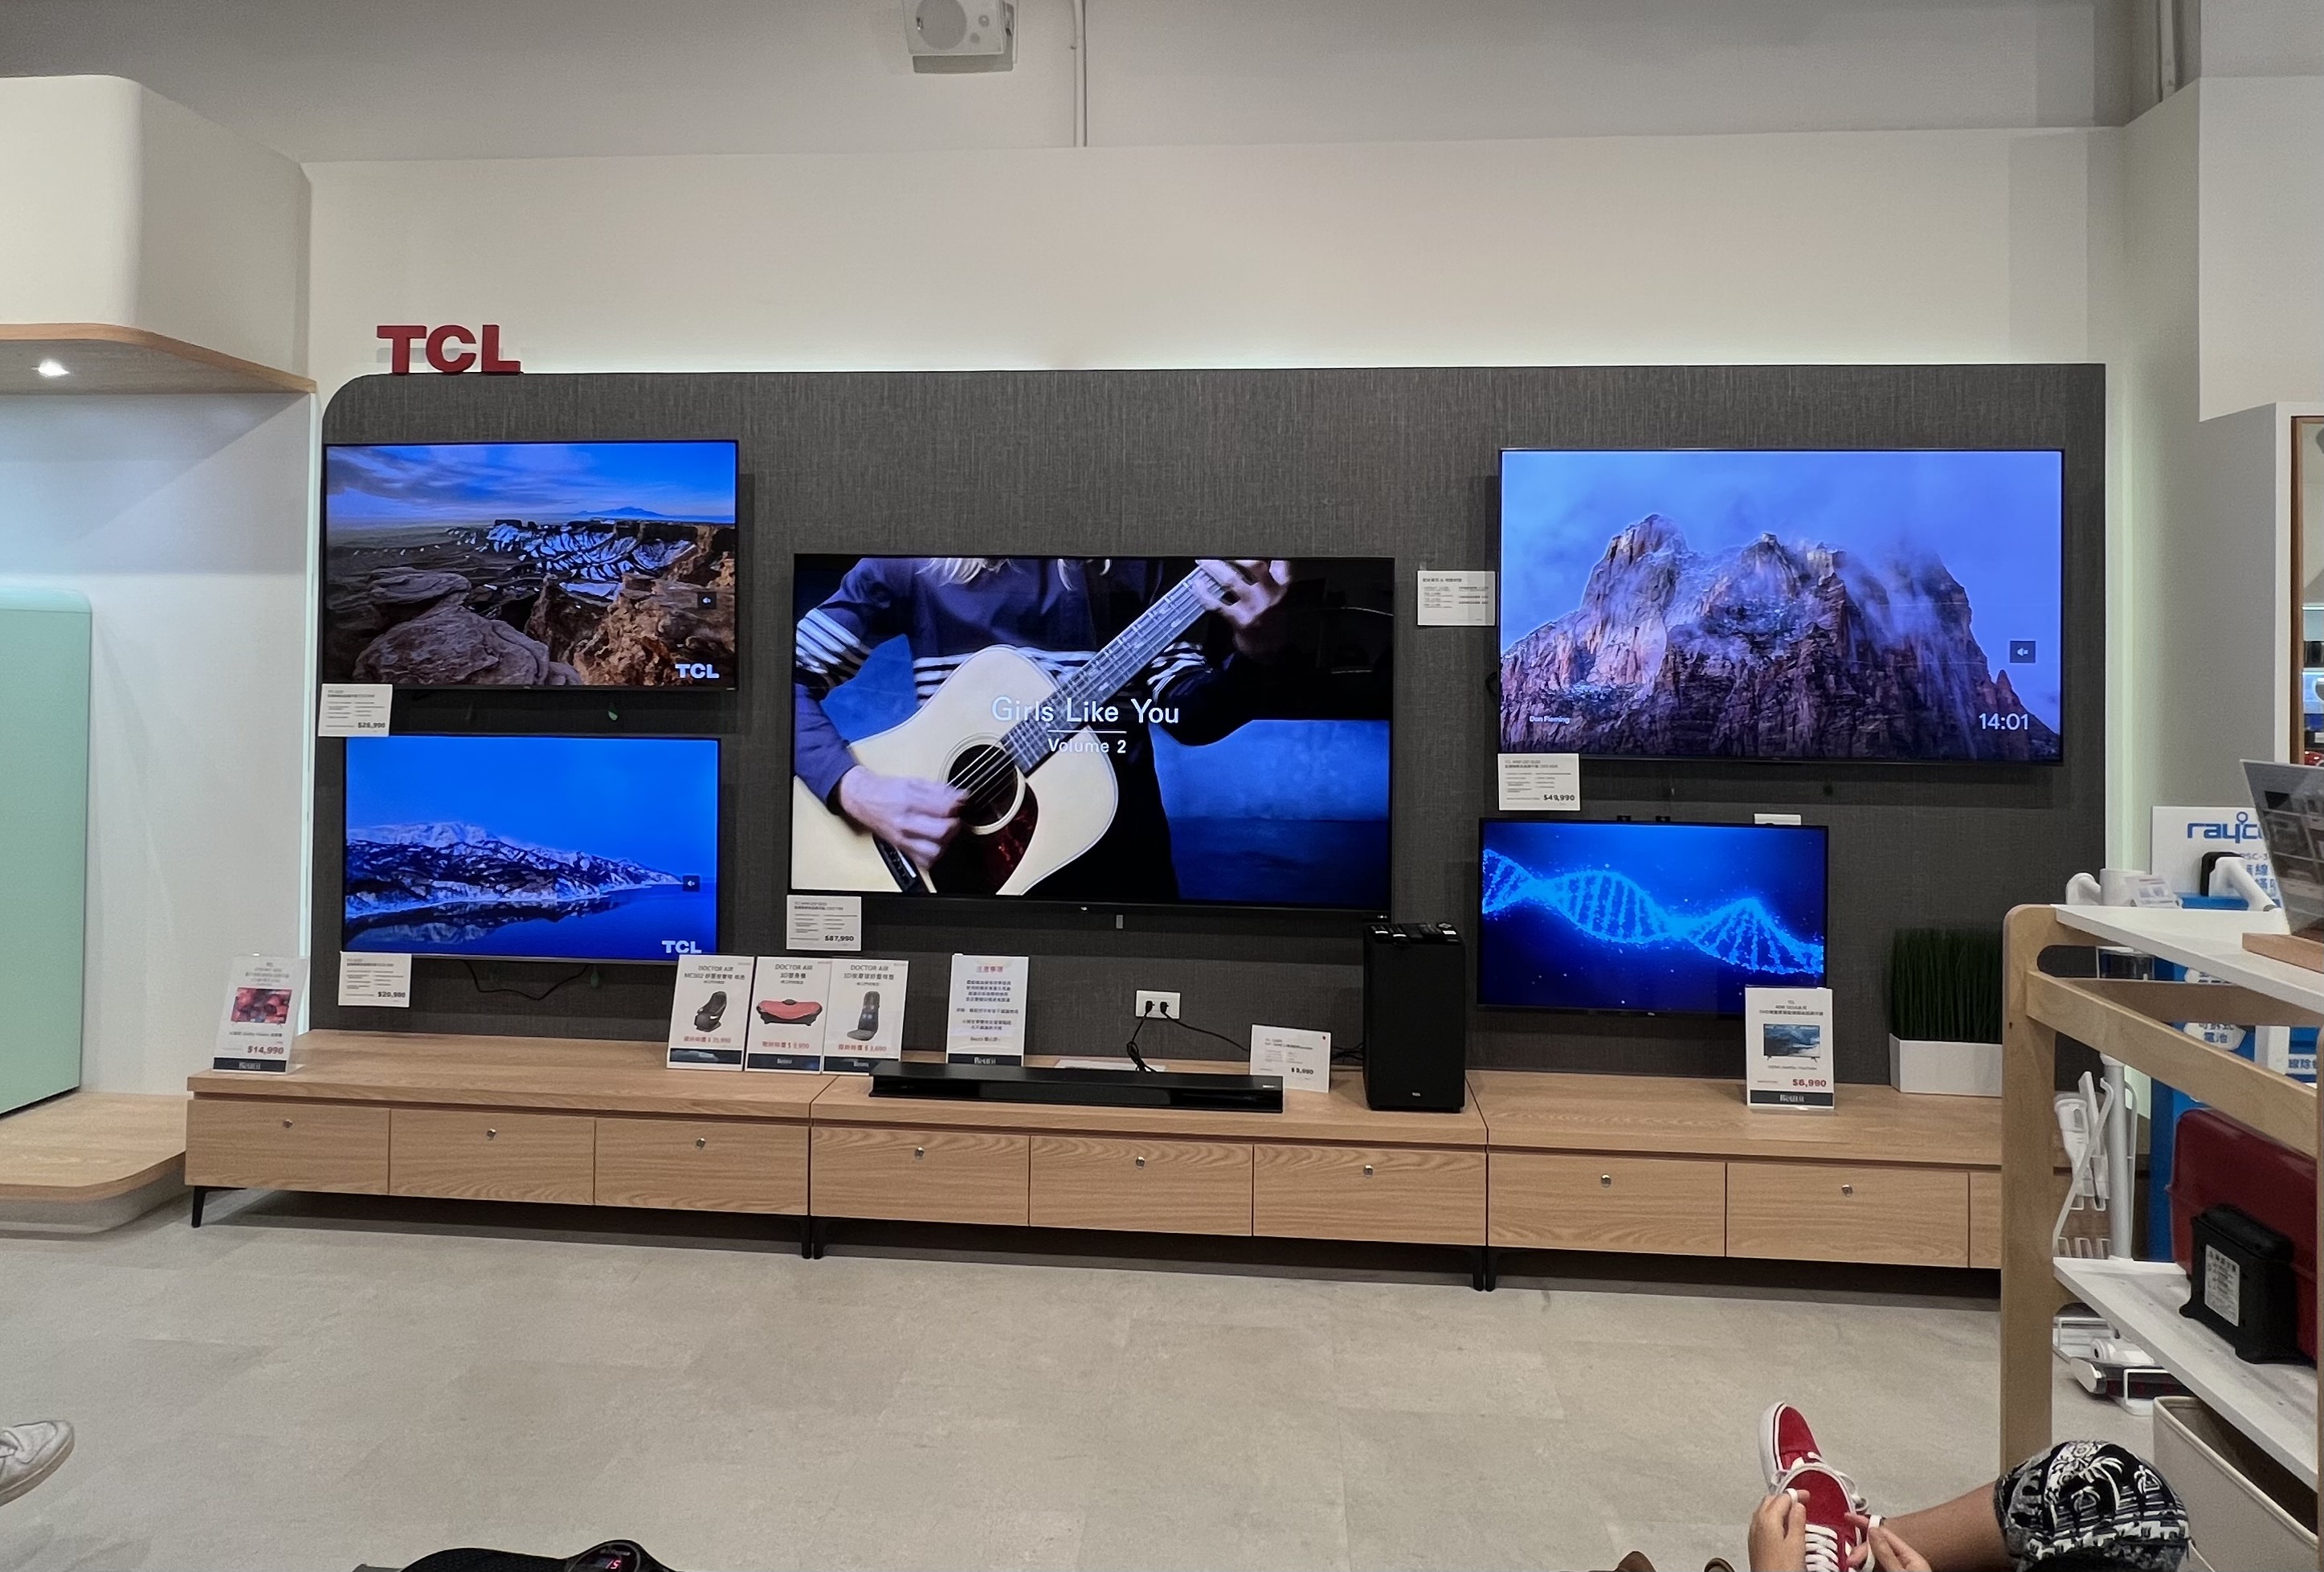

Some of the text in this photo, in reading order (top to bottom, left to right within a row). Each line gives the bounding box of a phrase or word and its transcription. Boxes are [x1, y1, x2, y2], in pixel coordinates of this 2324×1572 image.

[377, 325, 521, 375] TCL
[675, 663, 720, 679] TCL
[991, 696, 1179, 724] Girls Like You
[1978, 713, 2029, 730] 14:01
[1048, 737, 1126, 753] Volume 2
[661, 940, 703, 954] TCL
[247, 1045, 284, 1055] $14,990
